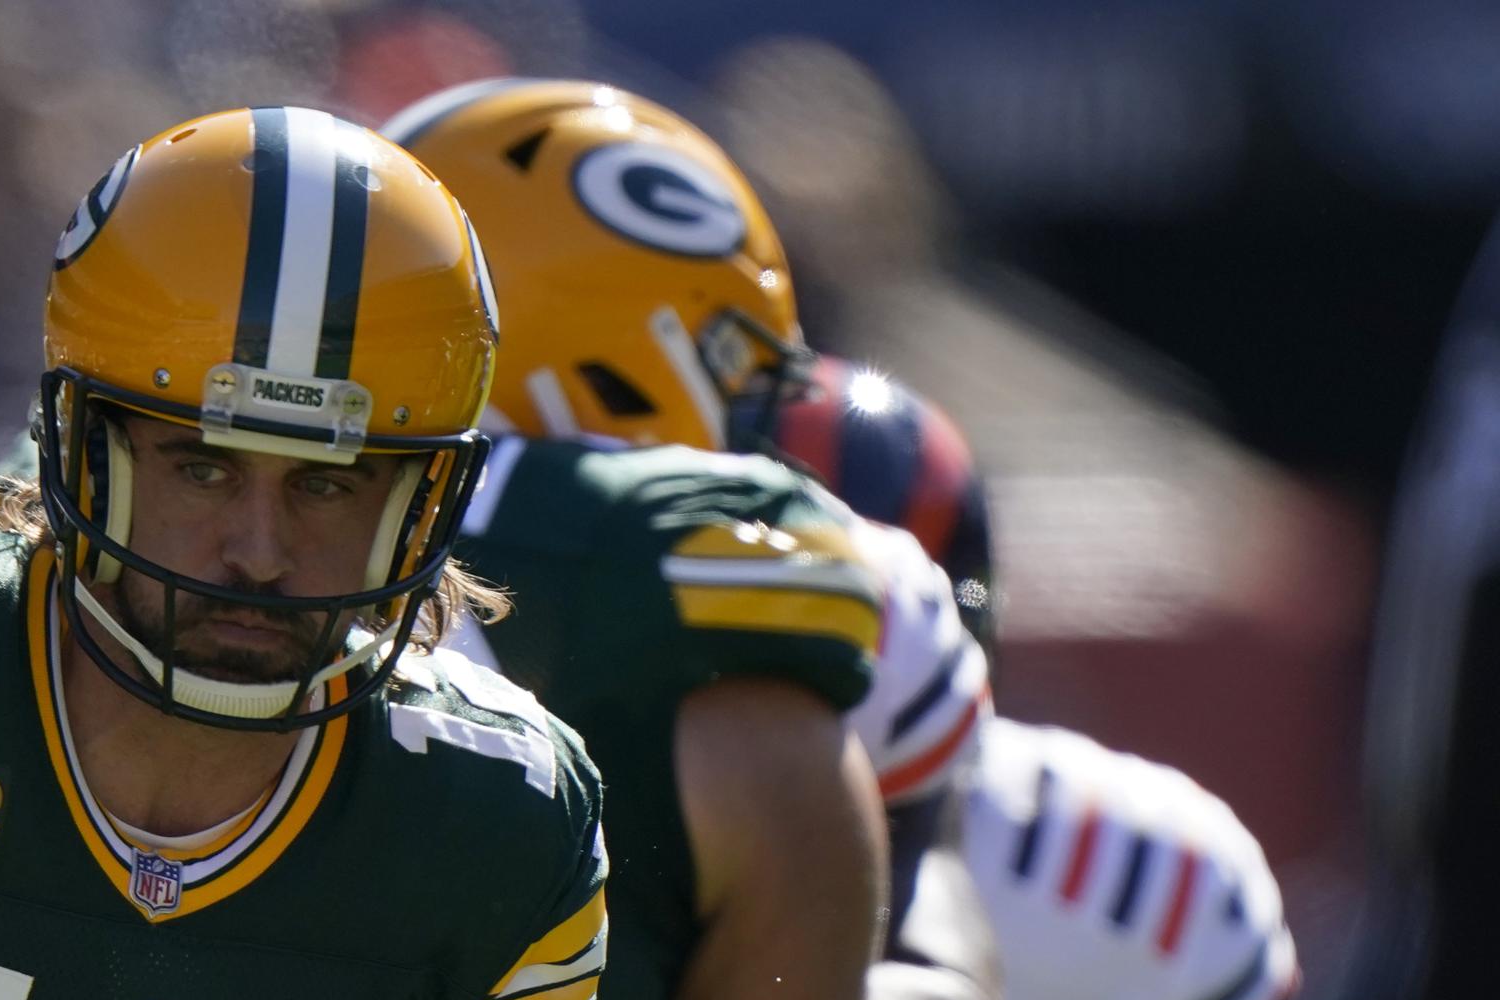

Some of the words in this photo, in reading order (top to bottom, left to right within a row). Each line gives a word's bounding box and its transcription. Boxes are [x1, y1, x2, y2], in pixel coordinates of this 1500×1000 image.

[579, 143, 746, 255] G
[253, 378, 325, 407] PACKERS
[138, 871, 177, 906] NFL
